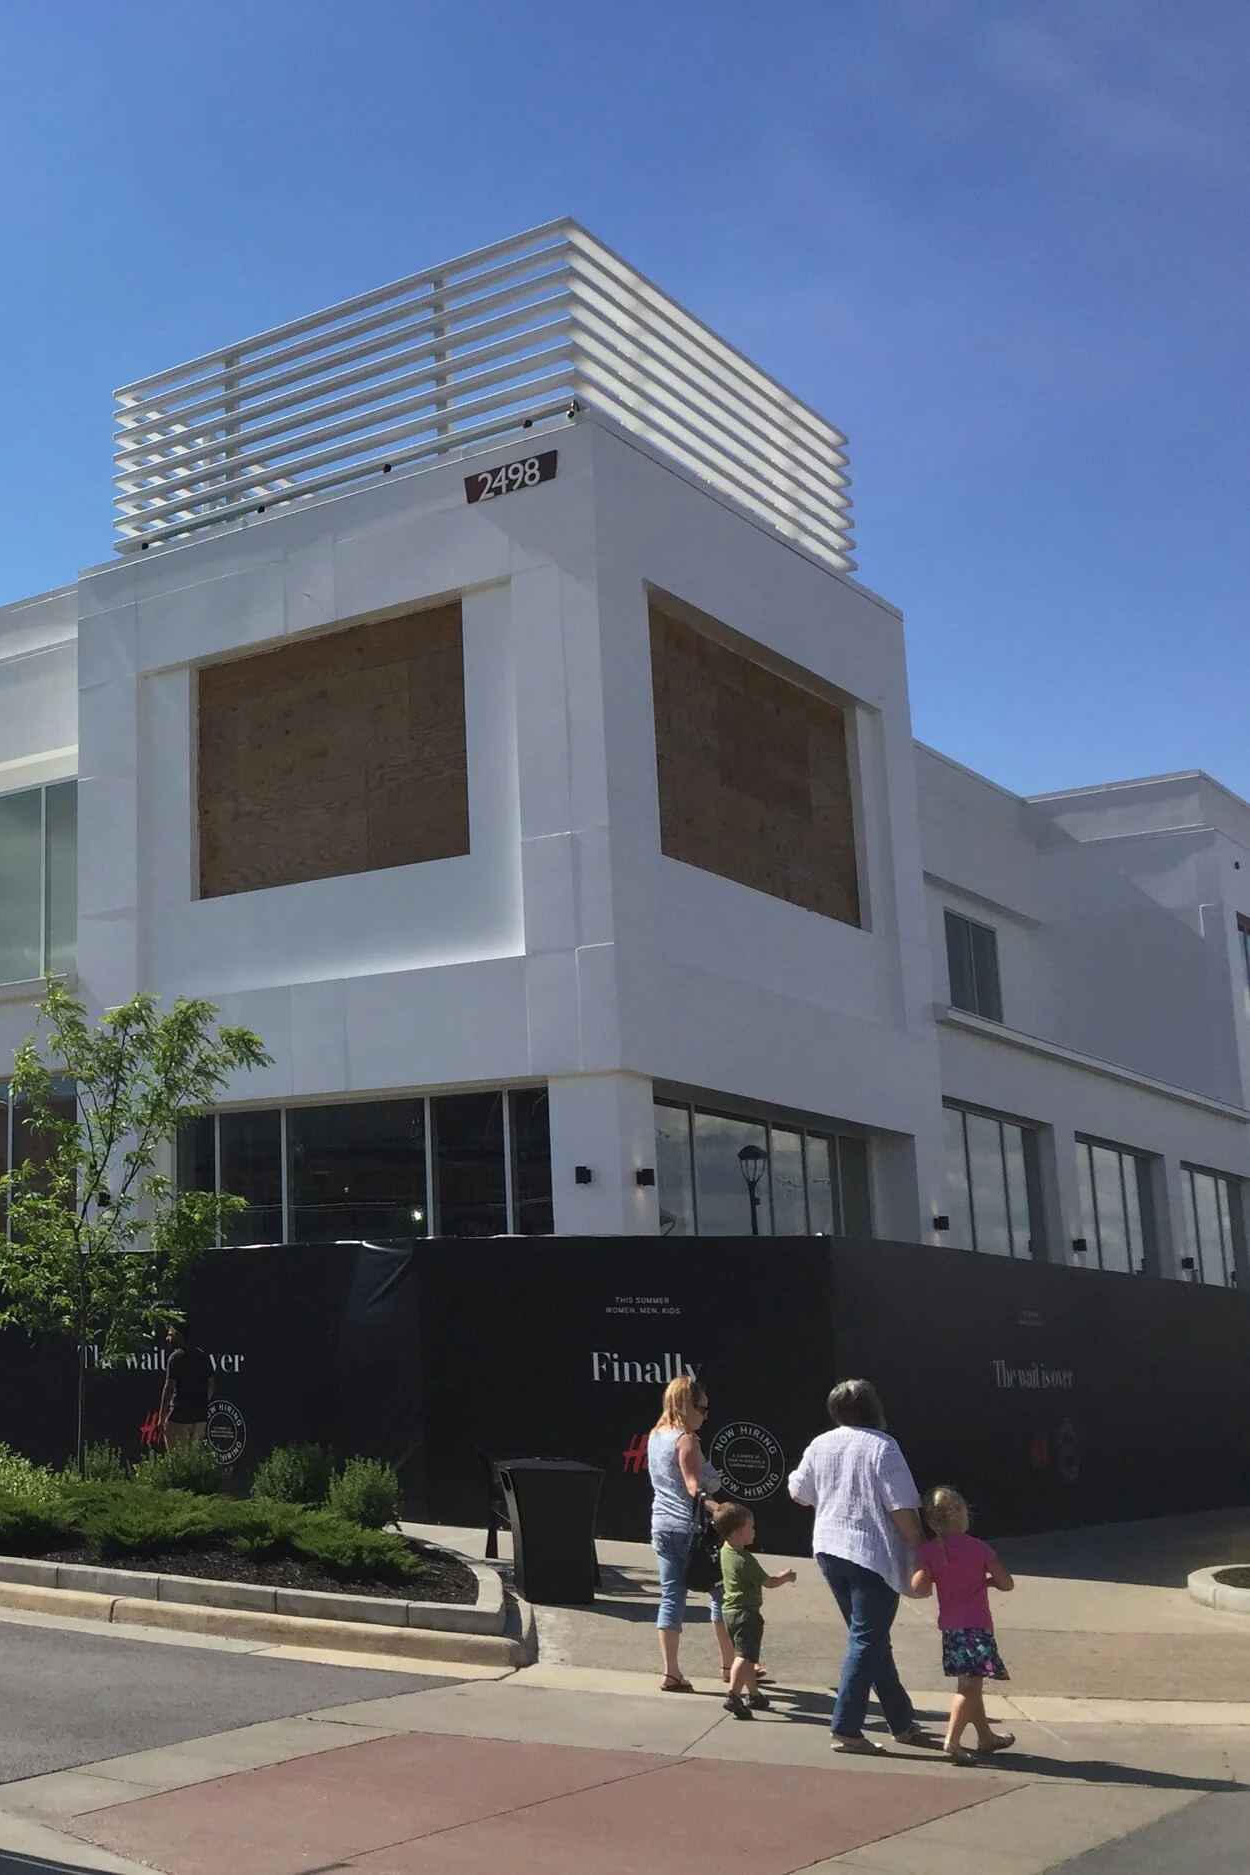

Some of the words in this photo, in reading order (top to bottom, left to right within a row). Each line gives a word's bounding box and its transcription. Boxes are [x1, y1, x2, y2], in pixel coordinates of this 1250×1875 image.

[478, 458, 541, 501] 2498
[615, 1296, 634, 1304] THIS
[635, 1296, 670, 1304] SUMMER
[661, 1307, 681, 1315] KIDS
[208, 1352, 245, 1373] ver
[591, 1351, 703, 1384] Finally
[992, 1359, 1016, 1388] The
[1016, 1362, 1040, 1389] wait
[1050, 1368, 1074, 1389] over
[714, 1427, 736, 1452] NOW
[740, 1425, 778, 1456] HIRING
[716, 1468, 740, 1493] NOW
[744, 1471, 779, 1497] HIRING
